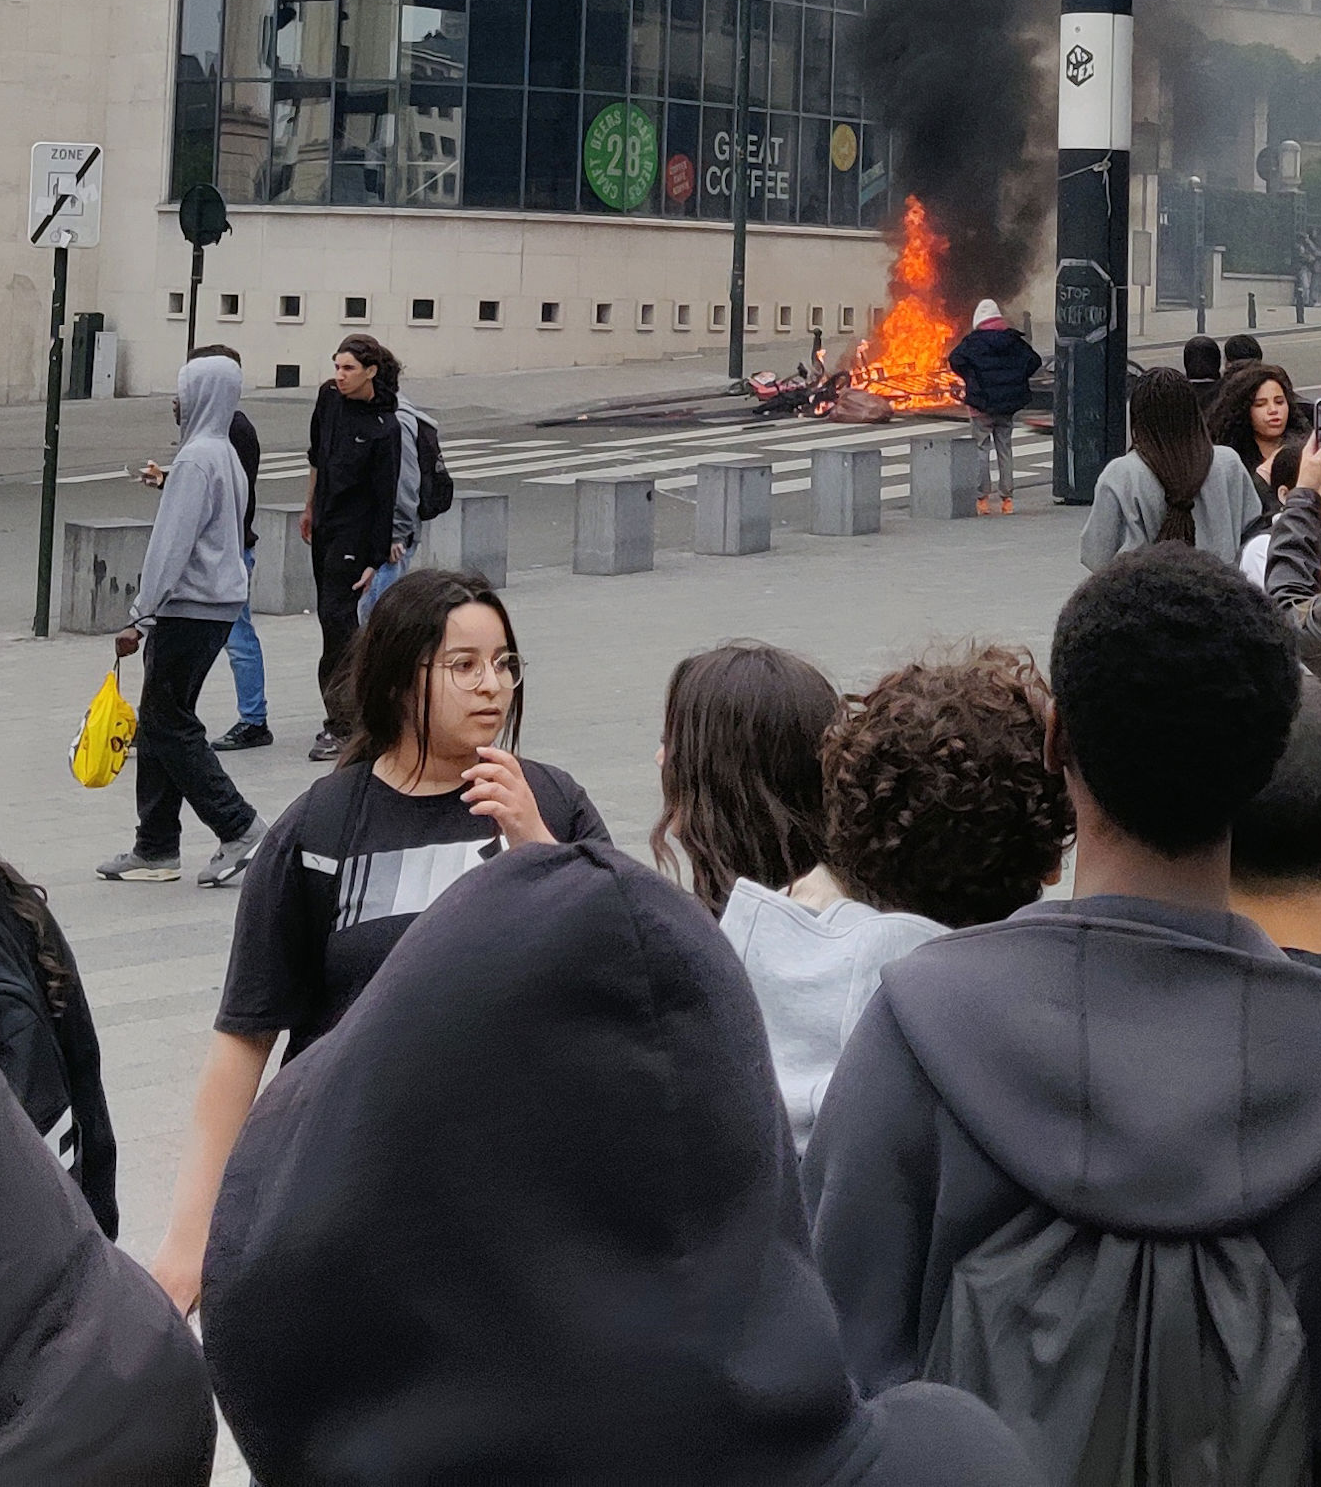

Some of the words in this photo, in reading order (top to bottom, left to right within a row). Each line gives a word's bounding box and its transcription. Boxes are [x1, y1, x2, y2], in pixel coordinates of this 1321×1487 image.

[51, 148, 84, 160] ZONE
[607, 134, 641, 178] 28
[714, 131, 784, 165] GEAT
[706, 165, 789, 200] COFEE
